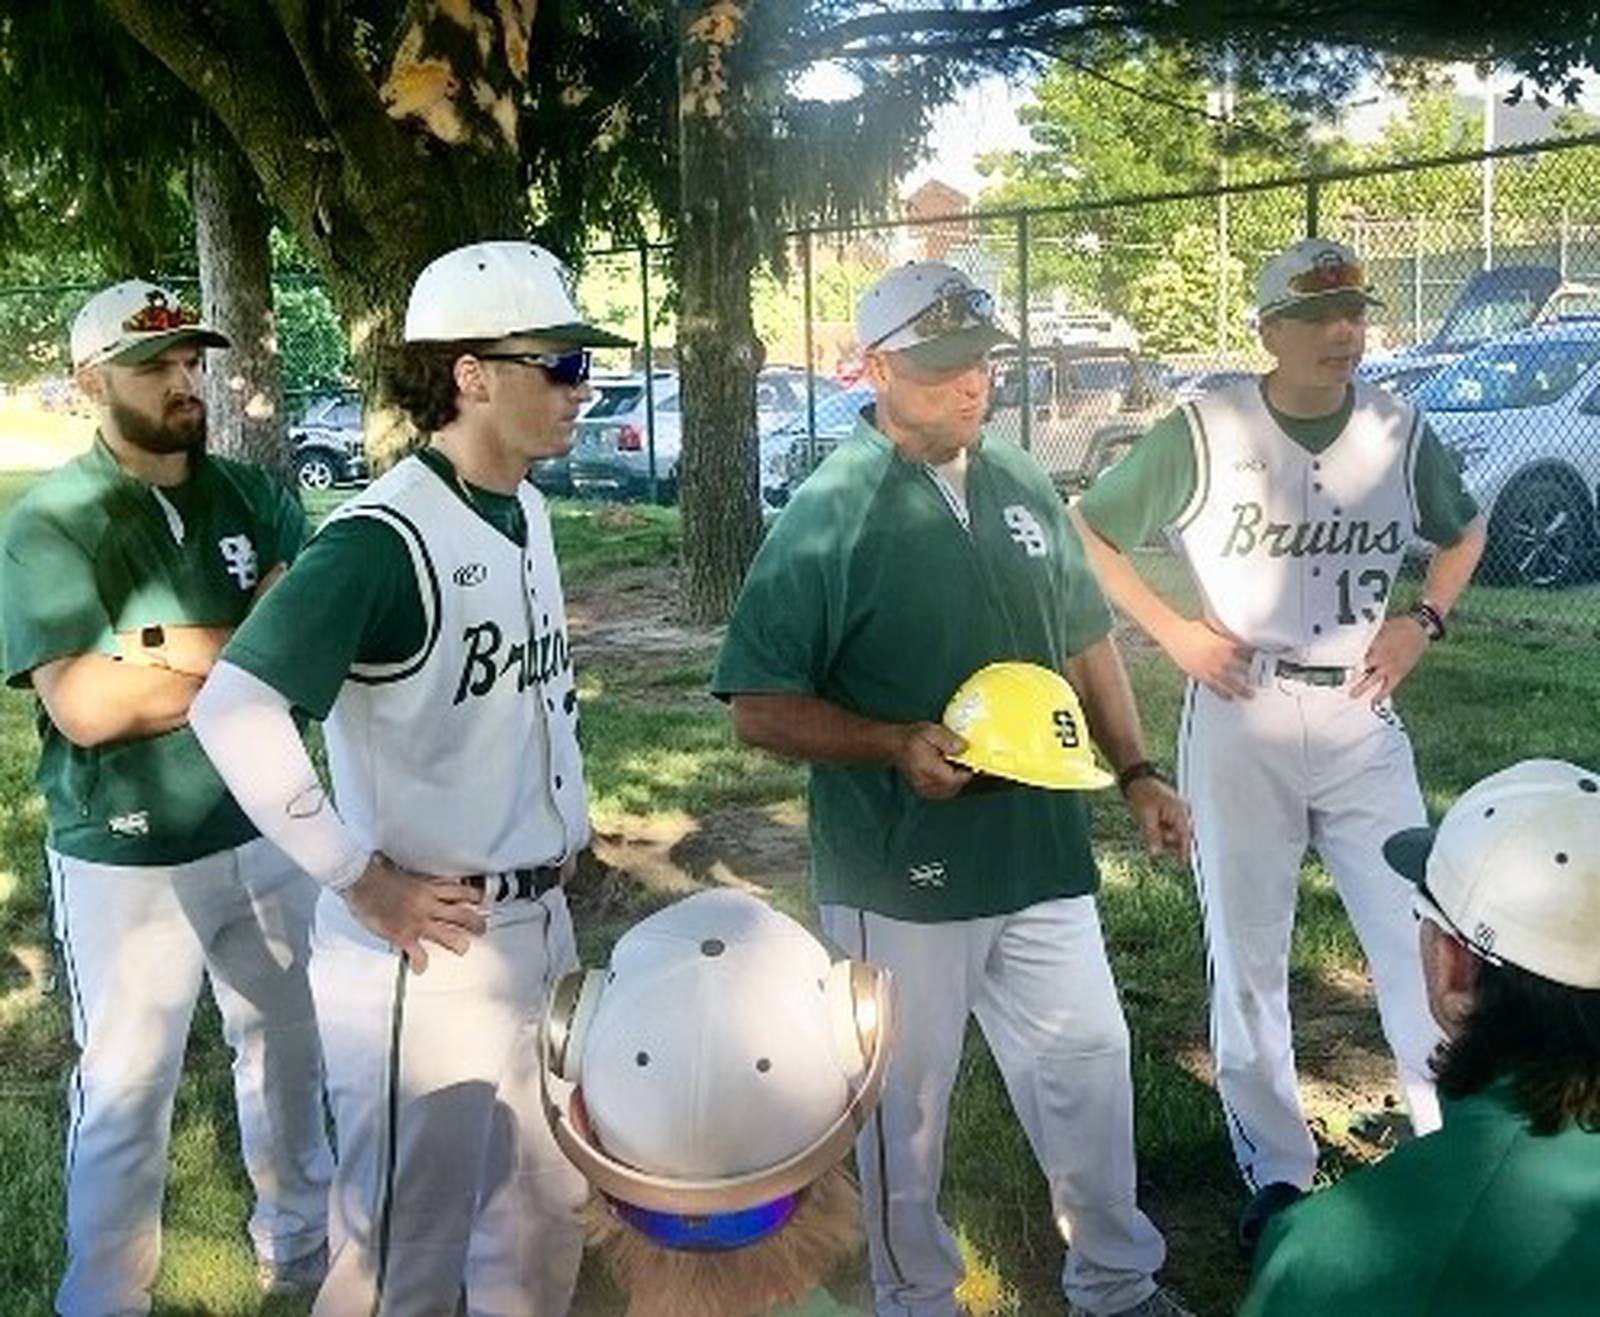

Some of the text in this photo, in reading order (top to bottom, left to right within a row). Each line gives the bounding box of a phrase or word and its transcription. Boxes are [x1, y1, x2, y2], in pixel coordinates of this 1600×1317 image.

[1220, 501, 1404, 557] Bruins
[1335, 569, 1391, 625] 13
[453, 621, 571, 706] Bruin
